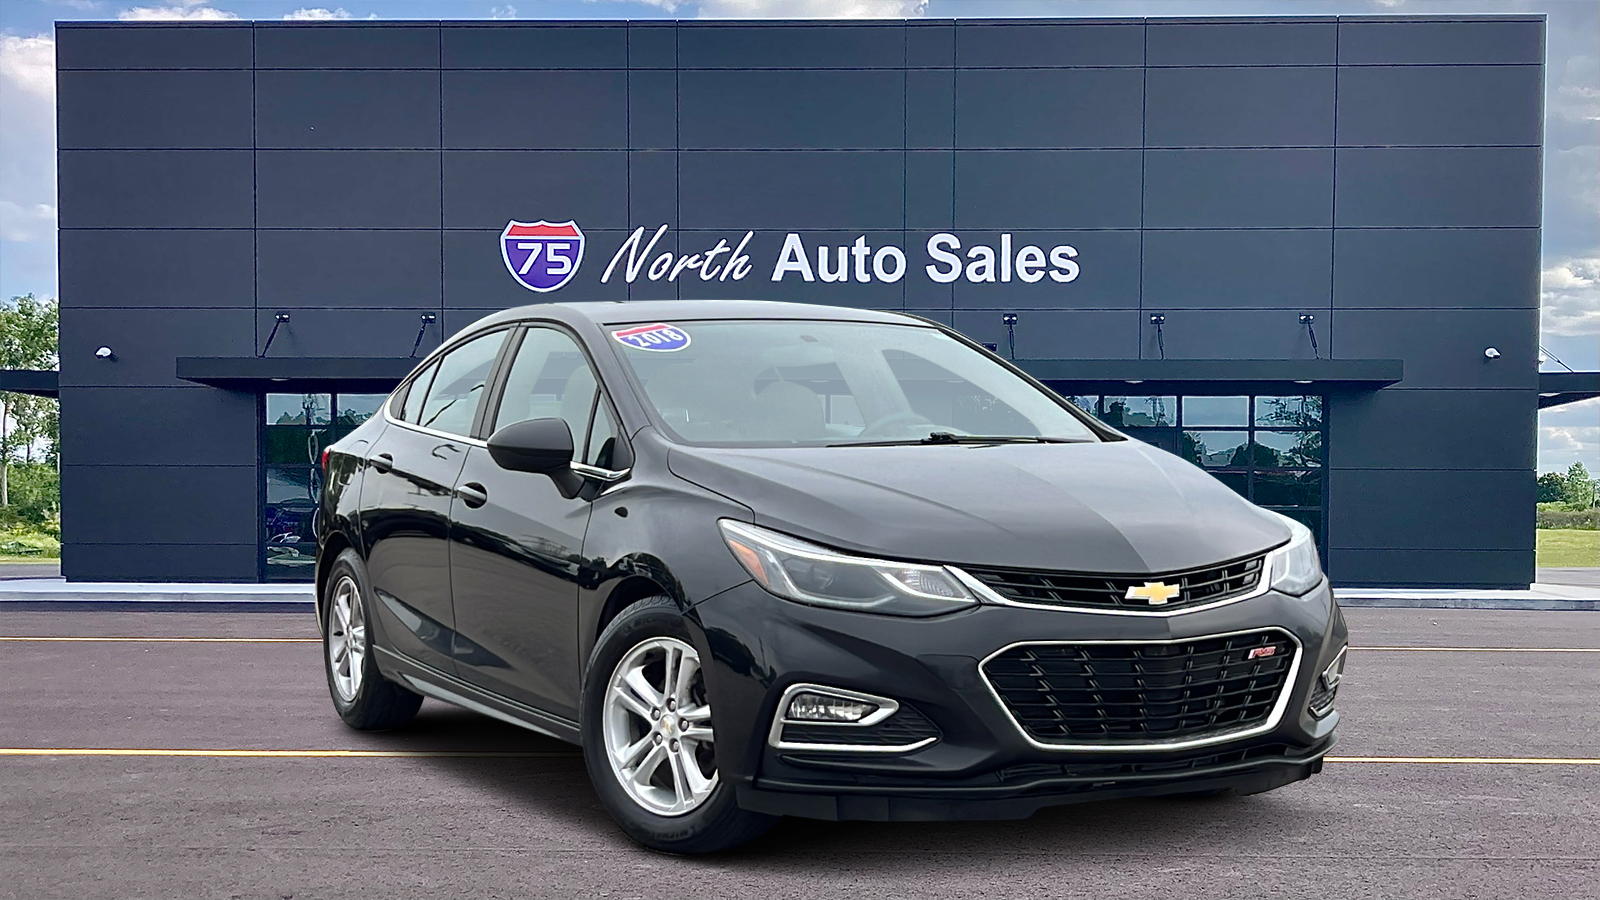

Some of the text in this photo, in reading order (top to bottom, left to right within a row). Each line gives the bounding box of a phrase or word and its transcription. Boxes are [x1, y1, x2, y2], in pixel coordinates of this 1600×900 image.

[517, 225, 1080, 283] 75 North Auto Sales
[627, 329, 684, 347] 2018
